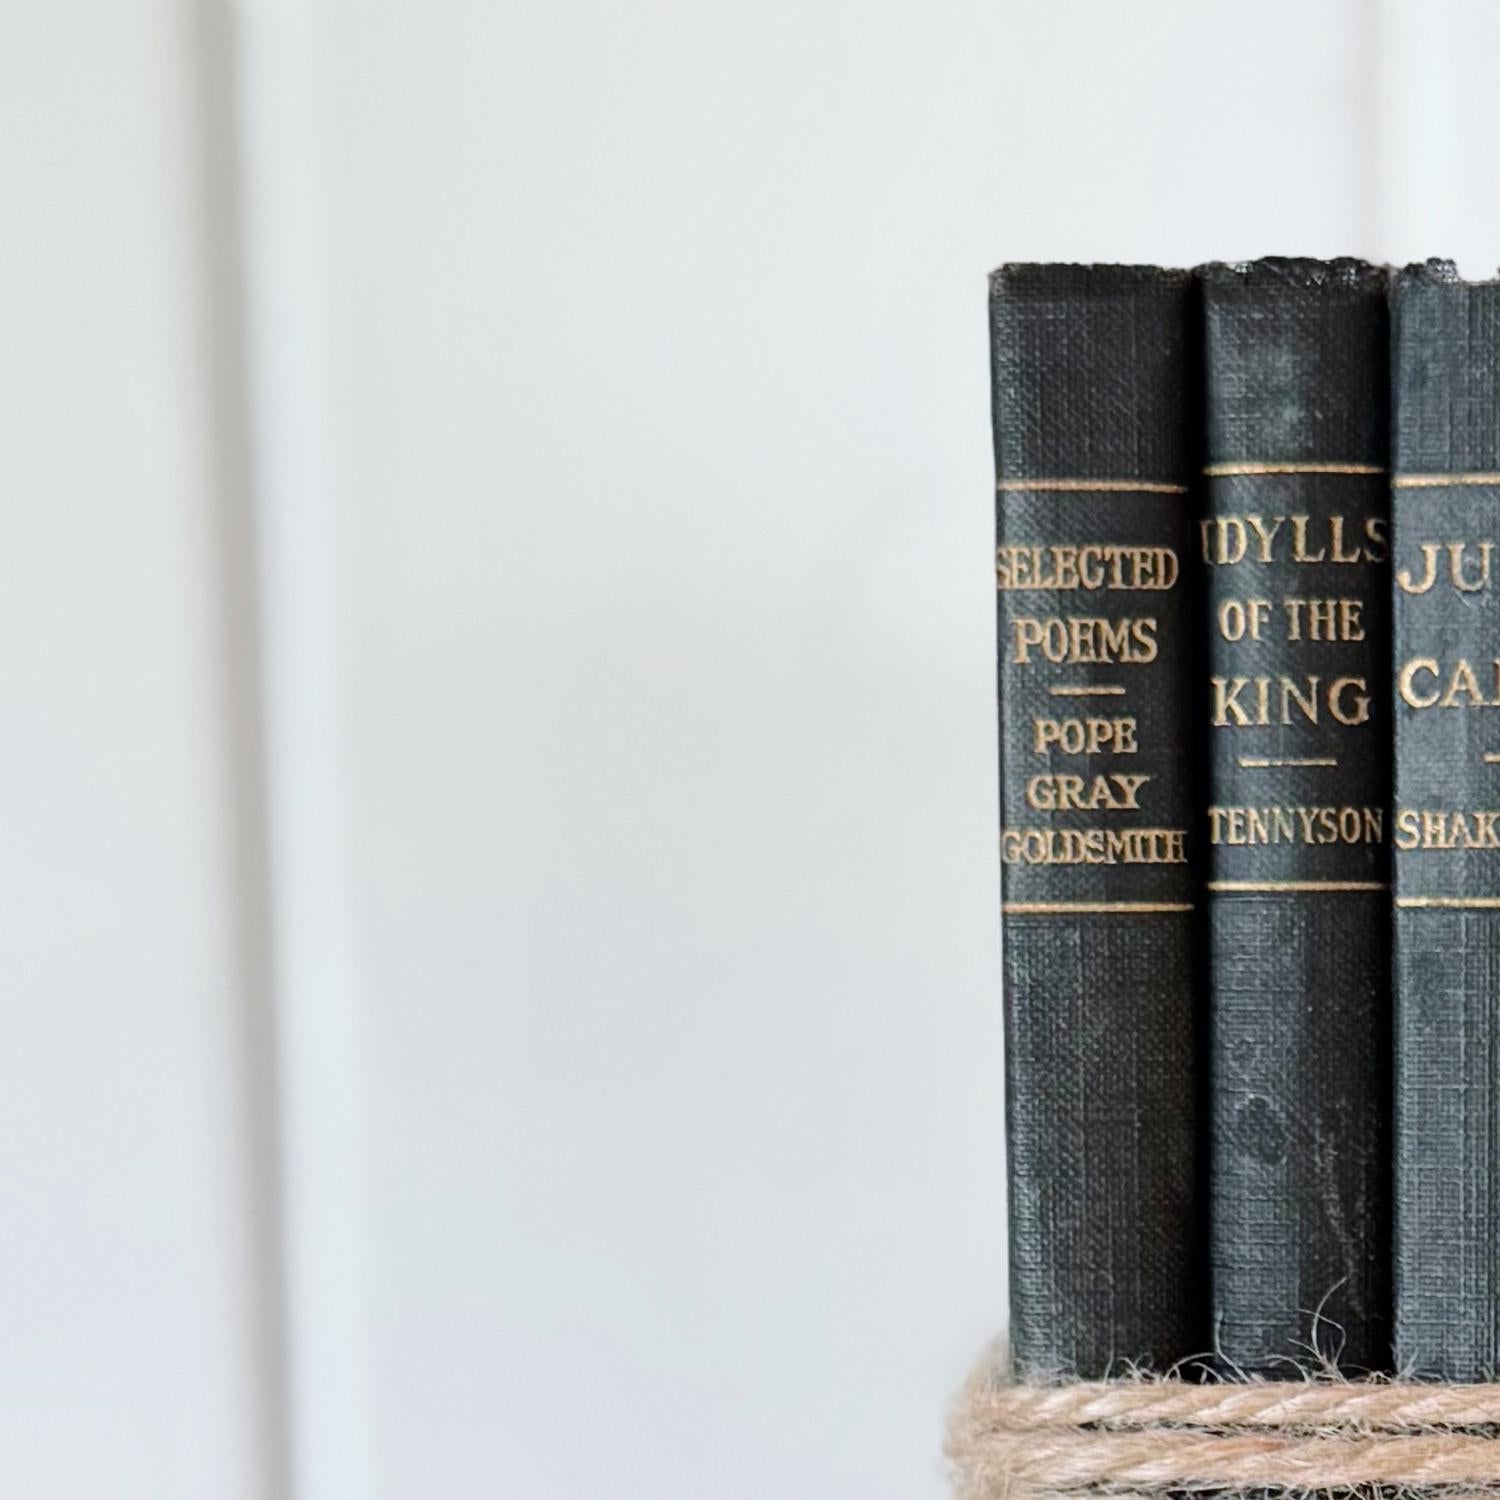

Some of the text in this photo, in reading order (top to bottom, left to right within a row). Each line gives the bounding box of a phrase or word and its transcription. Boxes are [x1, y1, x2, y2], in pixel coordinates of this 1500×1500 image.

[996, 543, 1179, 591] SELECTED
[1011, 617, 1158, 664] POEMS
[1218, 599, 1365, 642] OF THE
[1211, 676, 1371, 727] KING
[1034, 717, 1138, 754] POPE
[1027, 774, 1150, 809] GRAY
[1208, 807, 1383, 845] TENNYSON
[1002, 829, 1188, 864] GOLDSMITH
